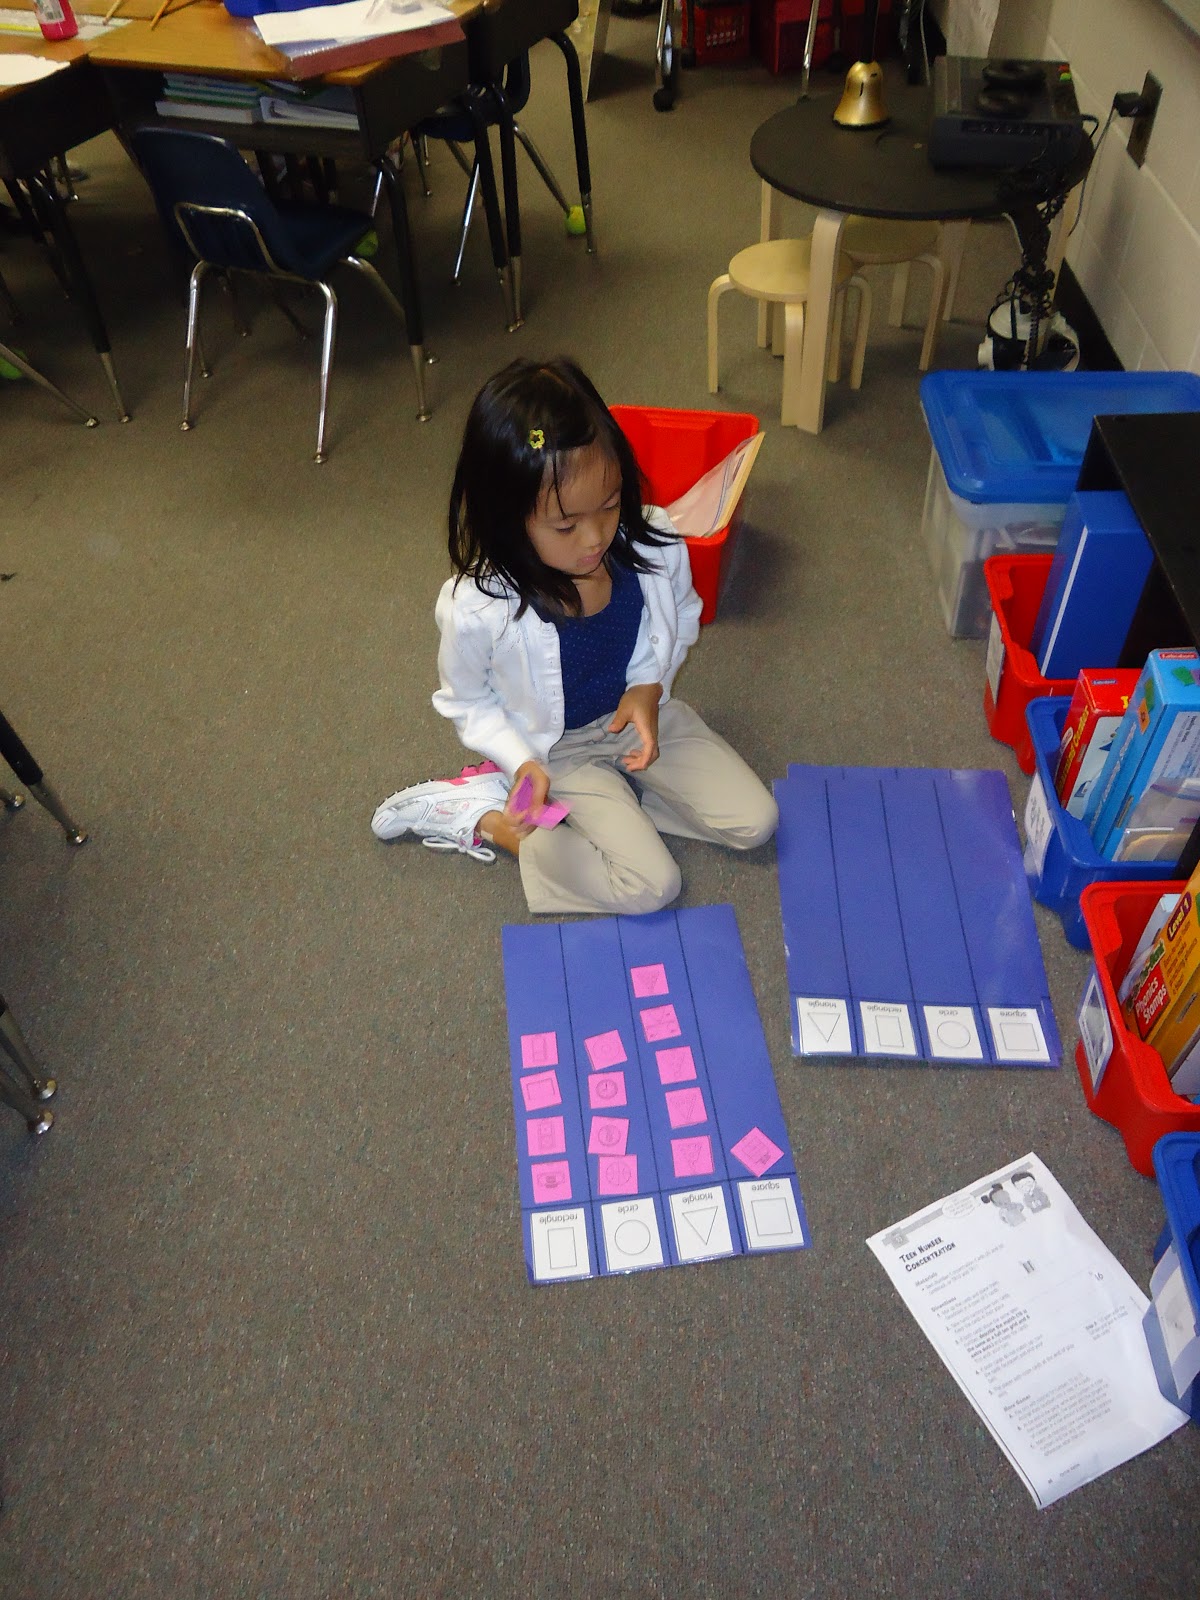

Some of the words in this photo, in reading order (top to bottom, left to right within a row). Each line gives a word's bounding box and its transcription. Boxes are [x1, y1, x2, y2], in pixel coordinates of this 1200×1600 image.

[1168, 906, 1184, 937] Level
[1135, 977, 1159, 1017] Phonics
[1143, 985, 1167, 1024] Stamps
[808, 1000, 837, 1009] triangle
[867, 1004, 902, 1014] rectangle
[938, 1009, 958, 1017] circle
[1000, 1010, 1028, 1018] square
[751, 1181, 780, 1192] square
[682, 1192, 713, 1205] triangle
[618, 1205, 639, 1215] circle
[539, 1213, 578, 1225] rectangle
